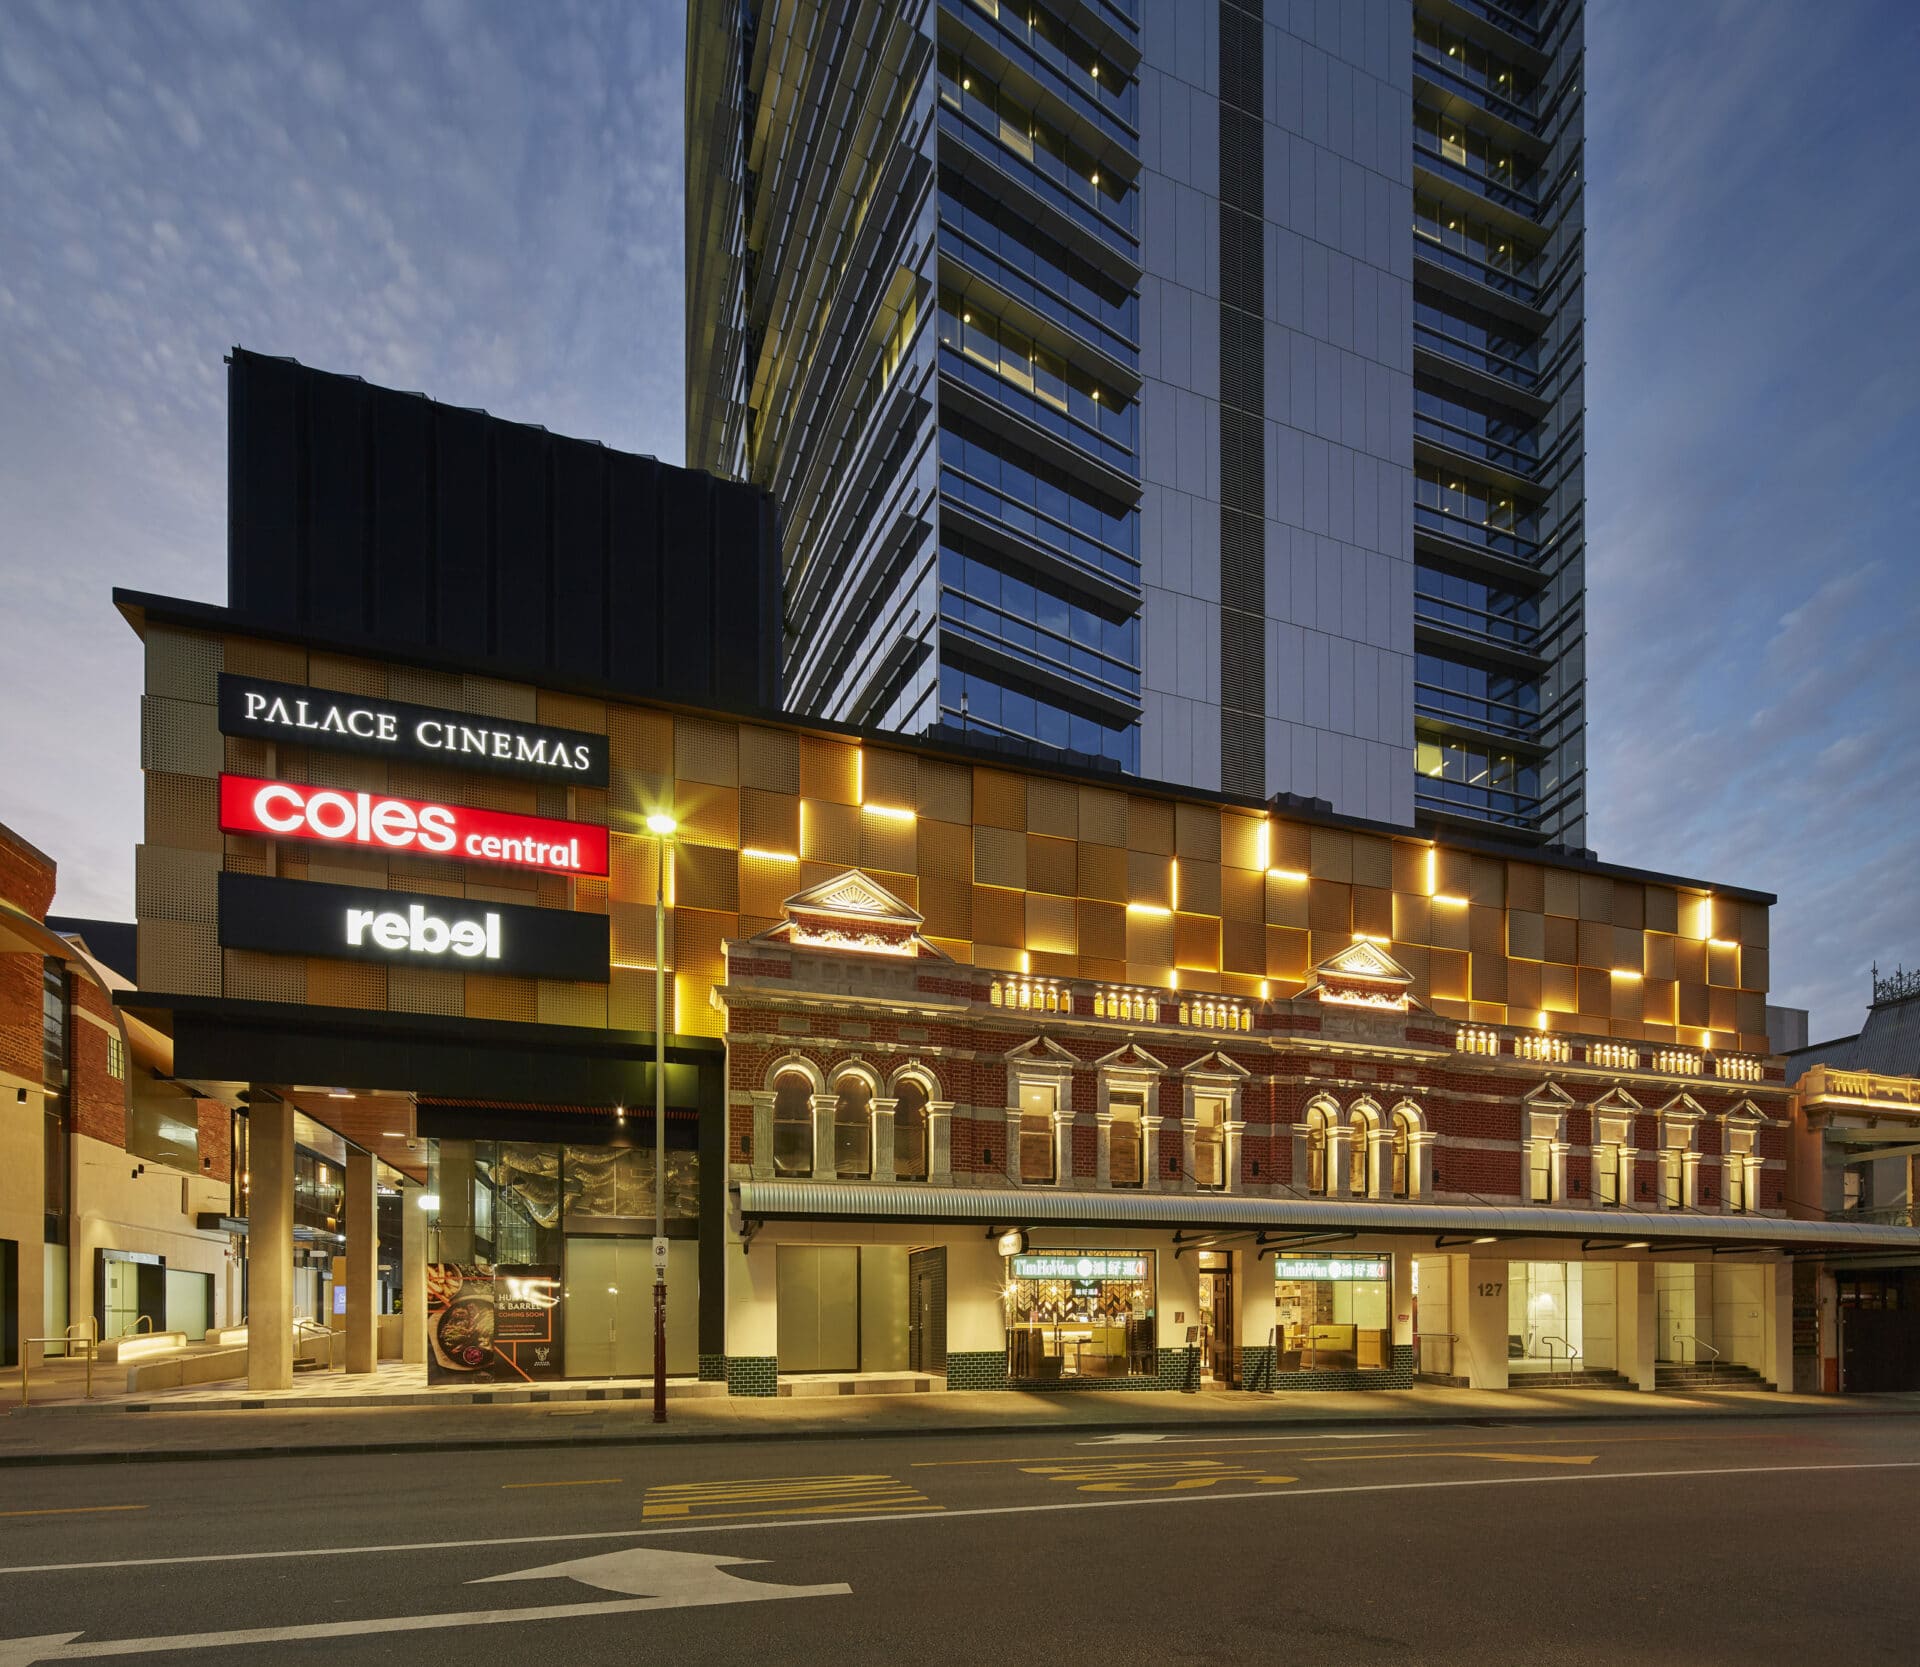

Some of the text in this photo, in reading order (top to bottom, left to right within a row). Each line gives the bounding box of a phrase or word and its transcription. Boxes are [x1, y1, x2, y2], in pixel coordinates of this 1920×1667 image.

[244, 692, 590, 770] PALACE CINEMAS
[253, 785, 581, 868] coles central
[346, 904, 501, 959] rebel
[1477, 1282, 1503, 1297] 127
